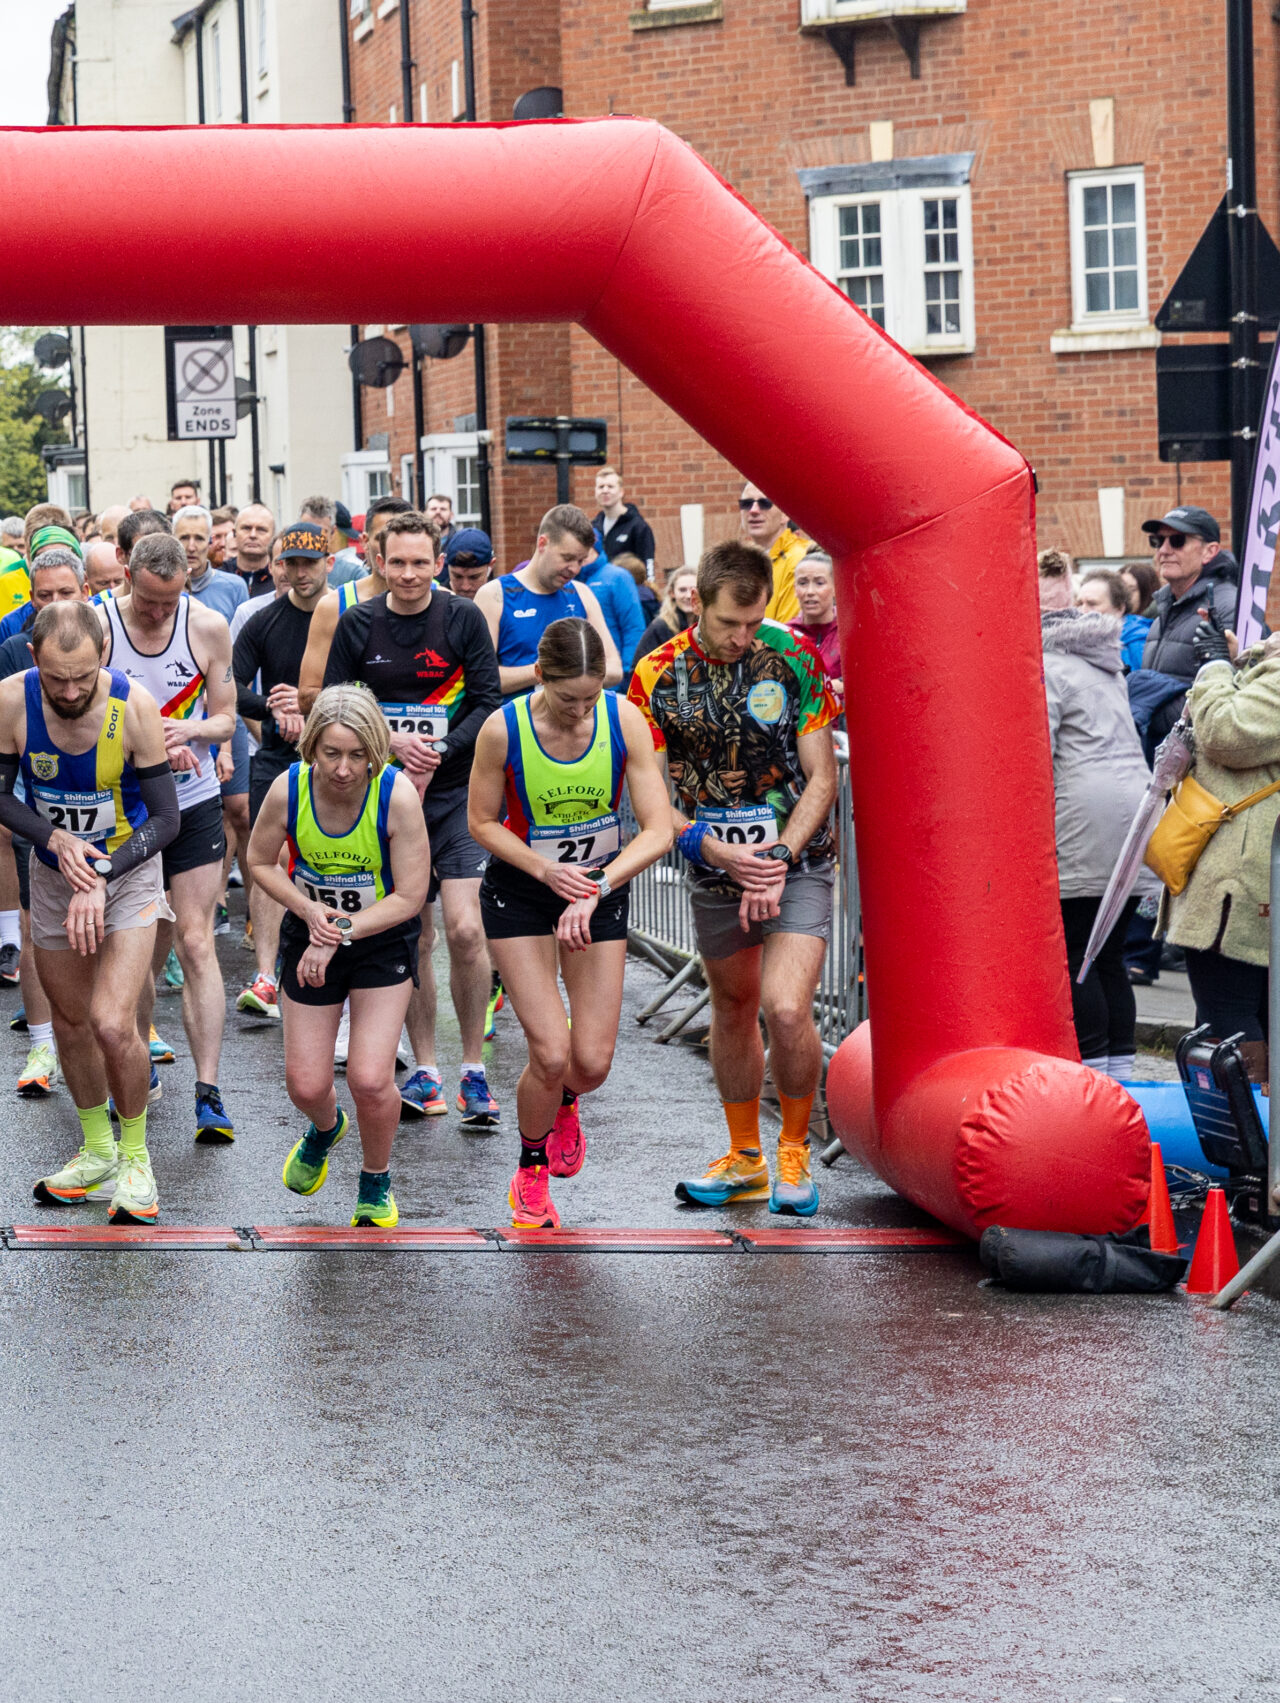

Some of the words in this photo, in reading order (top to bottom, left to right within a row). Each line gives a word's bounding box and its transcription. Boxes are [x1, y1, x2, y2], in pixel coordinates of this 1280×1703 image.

[192, 405, 222, 416] Zone
[185, 418, 231, 432] ENDS
[405, 705, 433, 713] Shifnal
[106, 705, 119, 740] soar
[63, 793, 96, 801] Shifnal
[97, 791, 112, 799] 10k
[536, 785, 605, 802] TELFORD
[48, 805, 98, 832] 217
[726, 810, 756, 818] Shifnal
[757, 807, 773, 815] 10k
[569, 822, 600, 832] Shifnal
[600, 815, 616, 824] 10k
[558, 836, 595, 862] 27
[308, 851, 371, 865] TELFORD
[357, 874, 373, 882] 10k
[304, 883, 362, 913] 158
